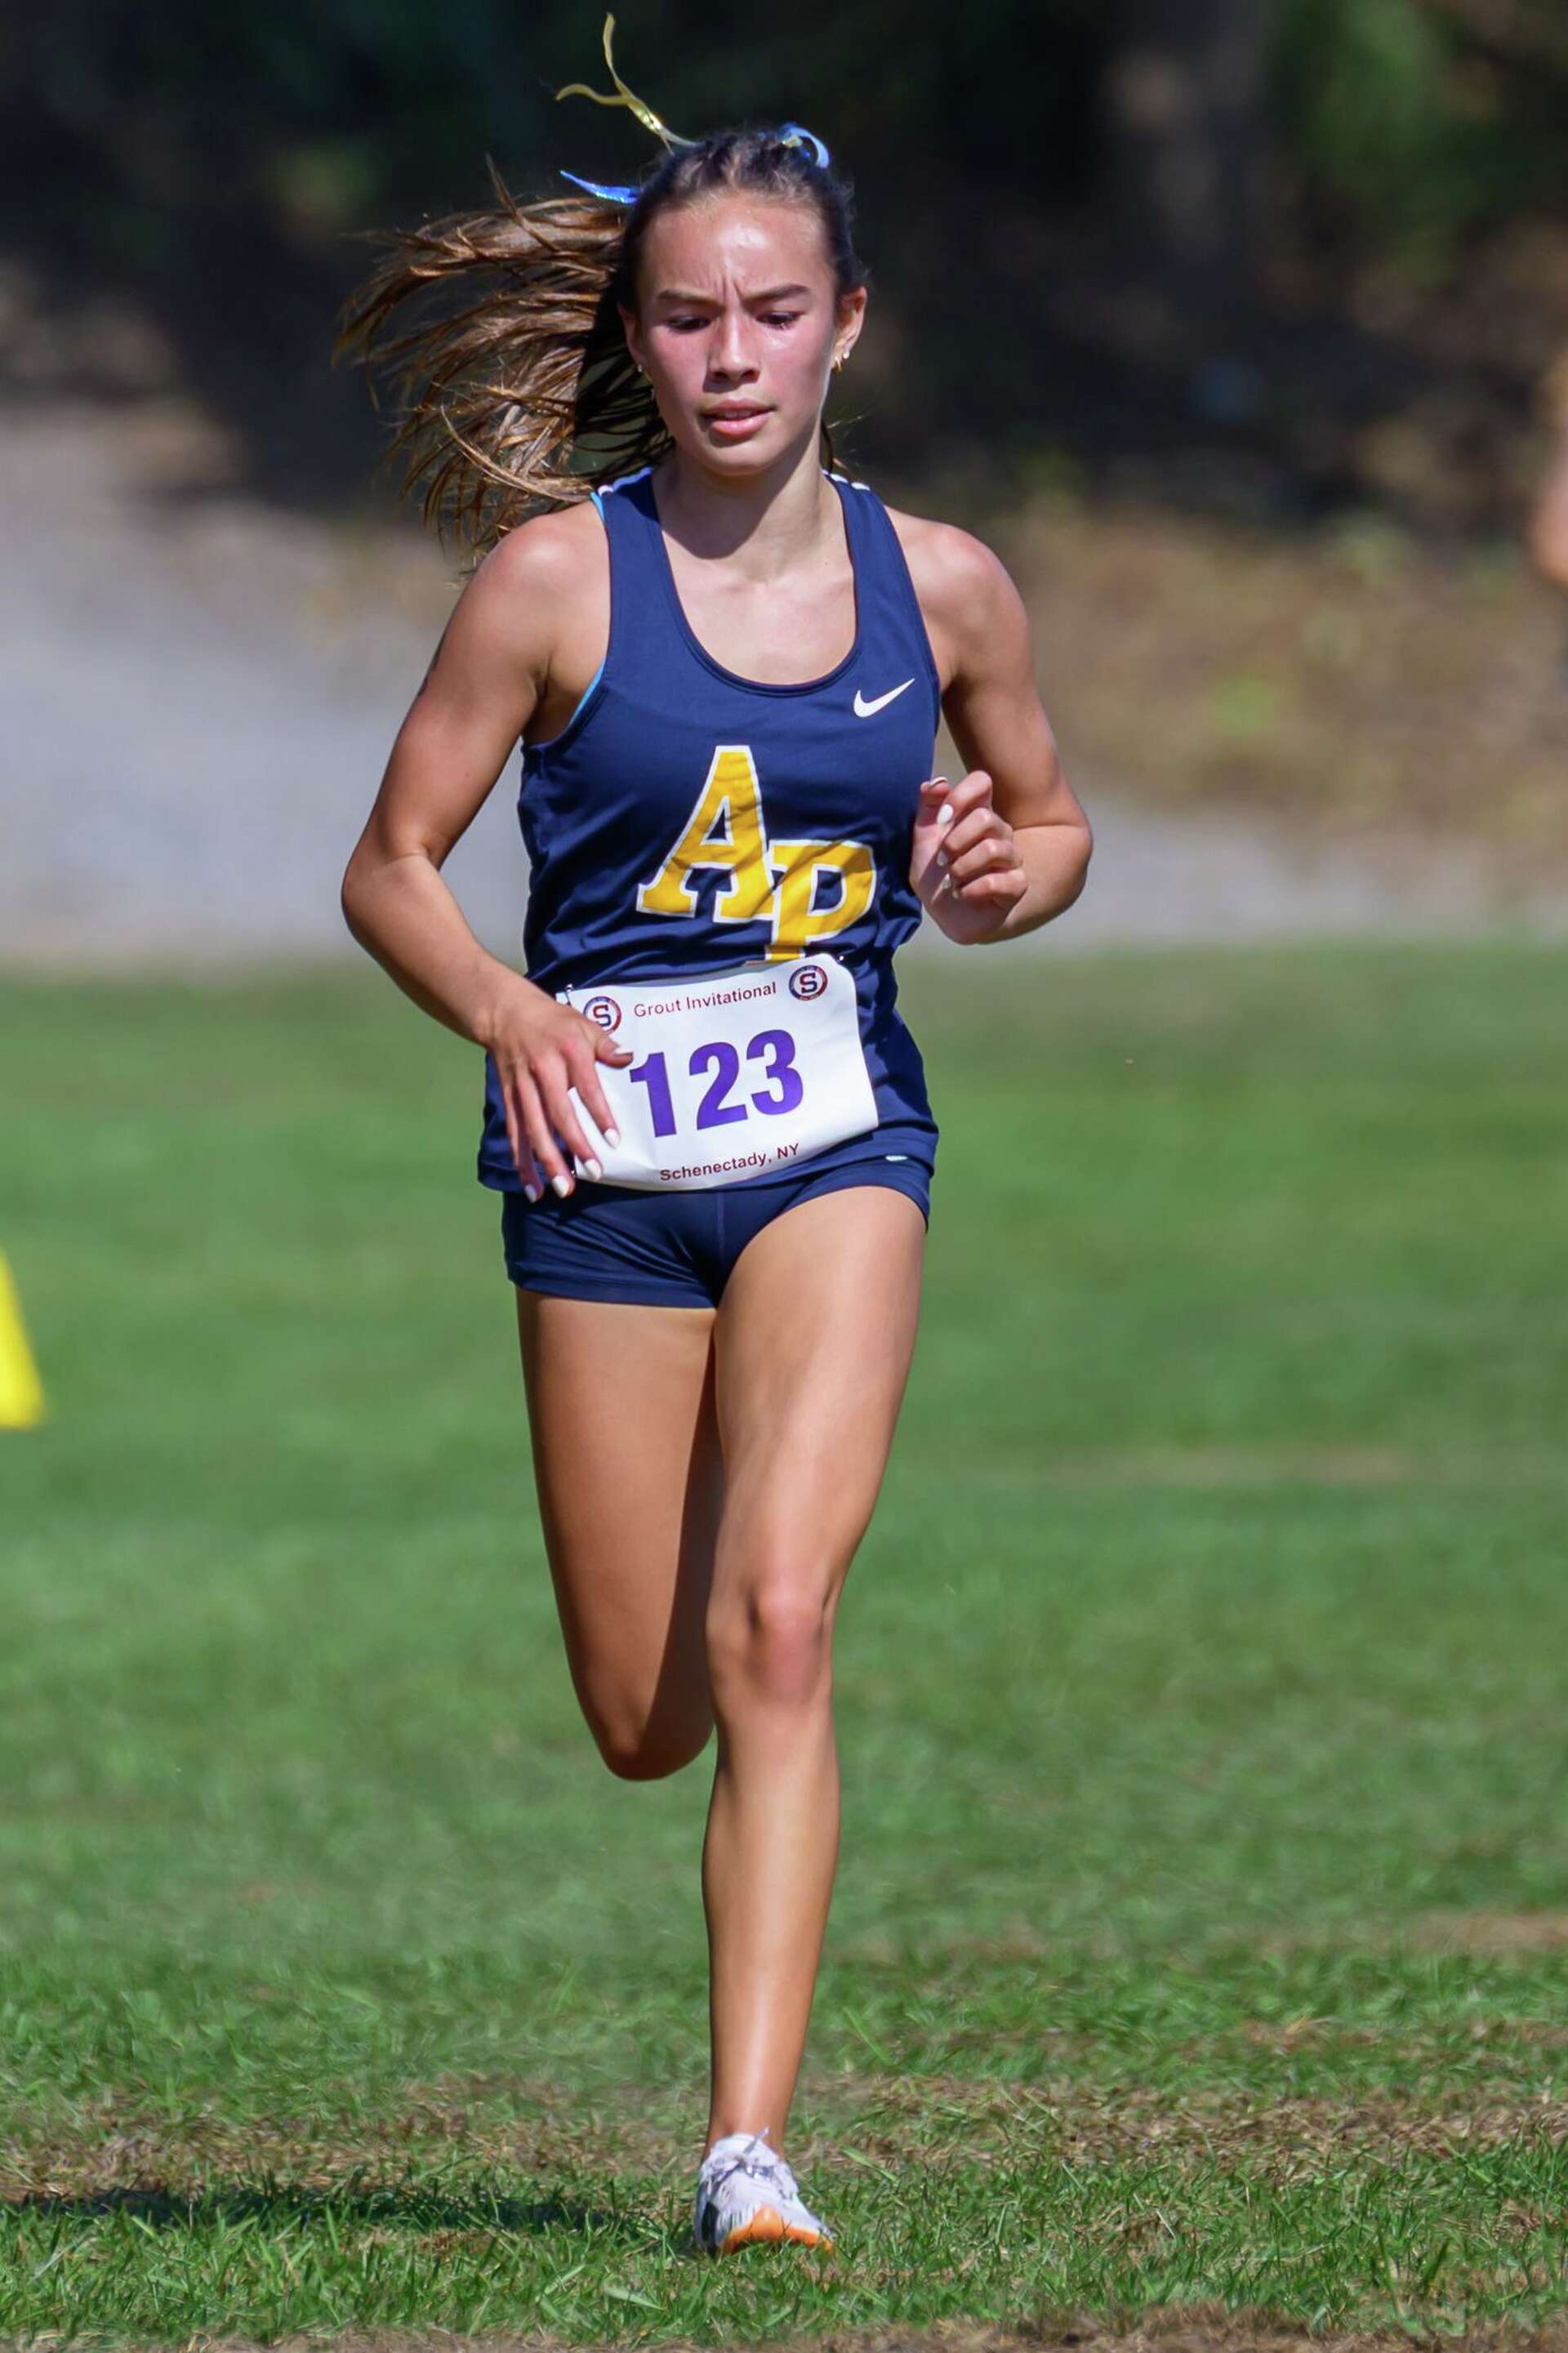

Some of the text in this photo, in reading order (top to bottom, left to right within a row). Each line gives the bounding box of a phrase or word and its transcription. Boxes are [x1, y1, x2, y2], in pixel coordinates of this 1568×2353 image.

[636, 745, 876, 963] AP
[634, 982, 777, 1017] Grout Invitational
[800, 972, 817, 994] S
[630, 1029, 804, 1138] 123
[660, 1143, 799, 1181] Schenectady, NY
